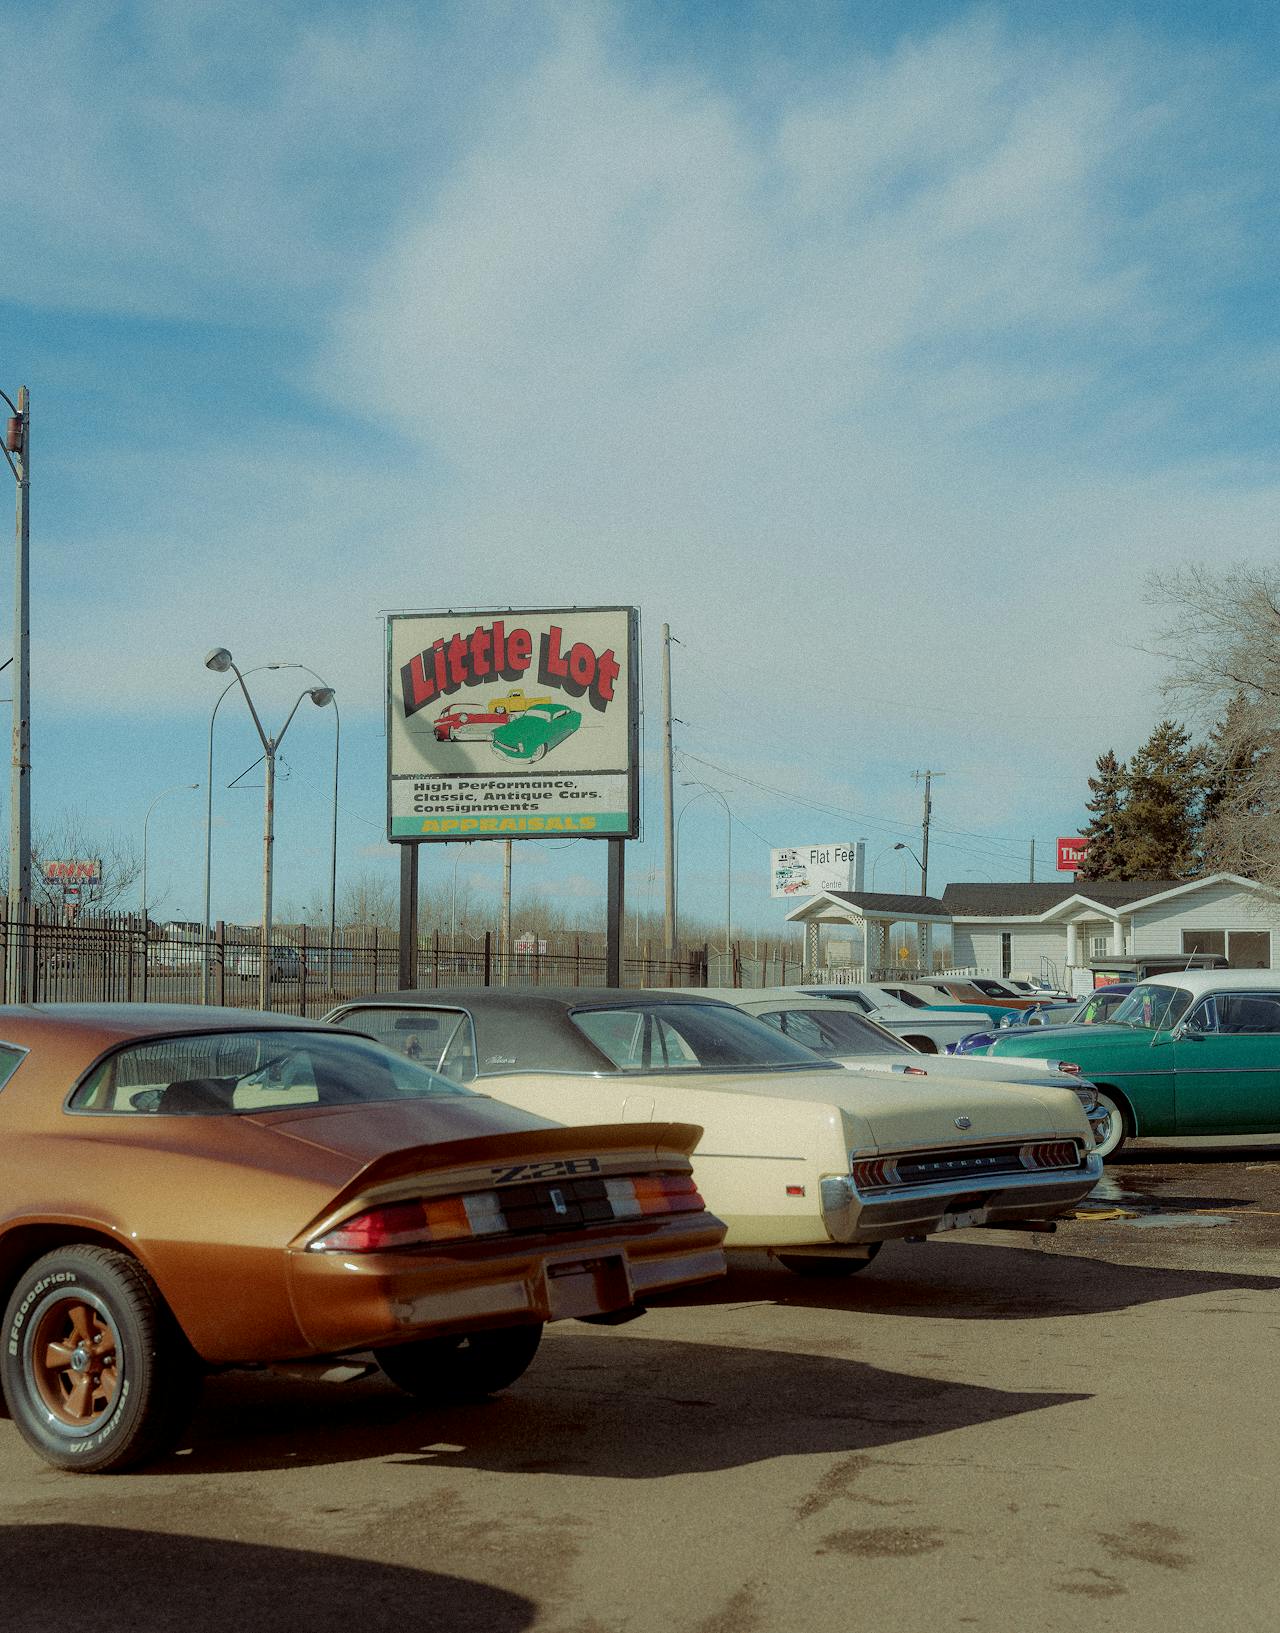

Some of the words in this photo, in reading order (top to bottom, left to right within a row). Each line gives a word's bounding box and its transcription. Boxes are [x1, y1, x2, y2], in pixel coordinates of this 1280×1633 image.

[401, 620, 532, 714] Little
[539, 625, 621, 712] Lot
[414, 783, 452, 792] High
[458, 780, 577, 790] Performance,
[413, 793, 477, 801] Classic,
[483, 791, 553, 800] Antique
[559, 790, 602, 799] Cars.
[413, 803, 539, 813] Consignments
[421, 816, 597, 832] APPRAISALS
[810, 848, 830, 864] Flat
[834, 847, 855, 862] Fee
[1061, 847, 1088, 860] Thri
[48, 863, 95, 877] INN
[821, 880, 842, 889] Centre
[491, 1158, 600, 1184] Z28
[8, 1272, 77, 1356] BFGoodrich
